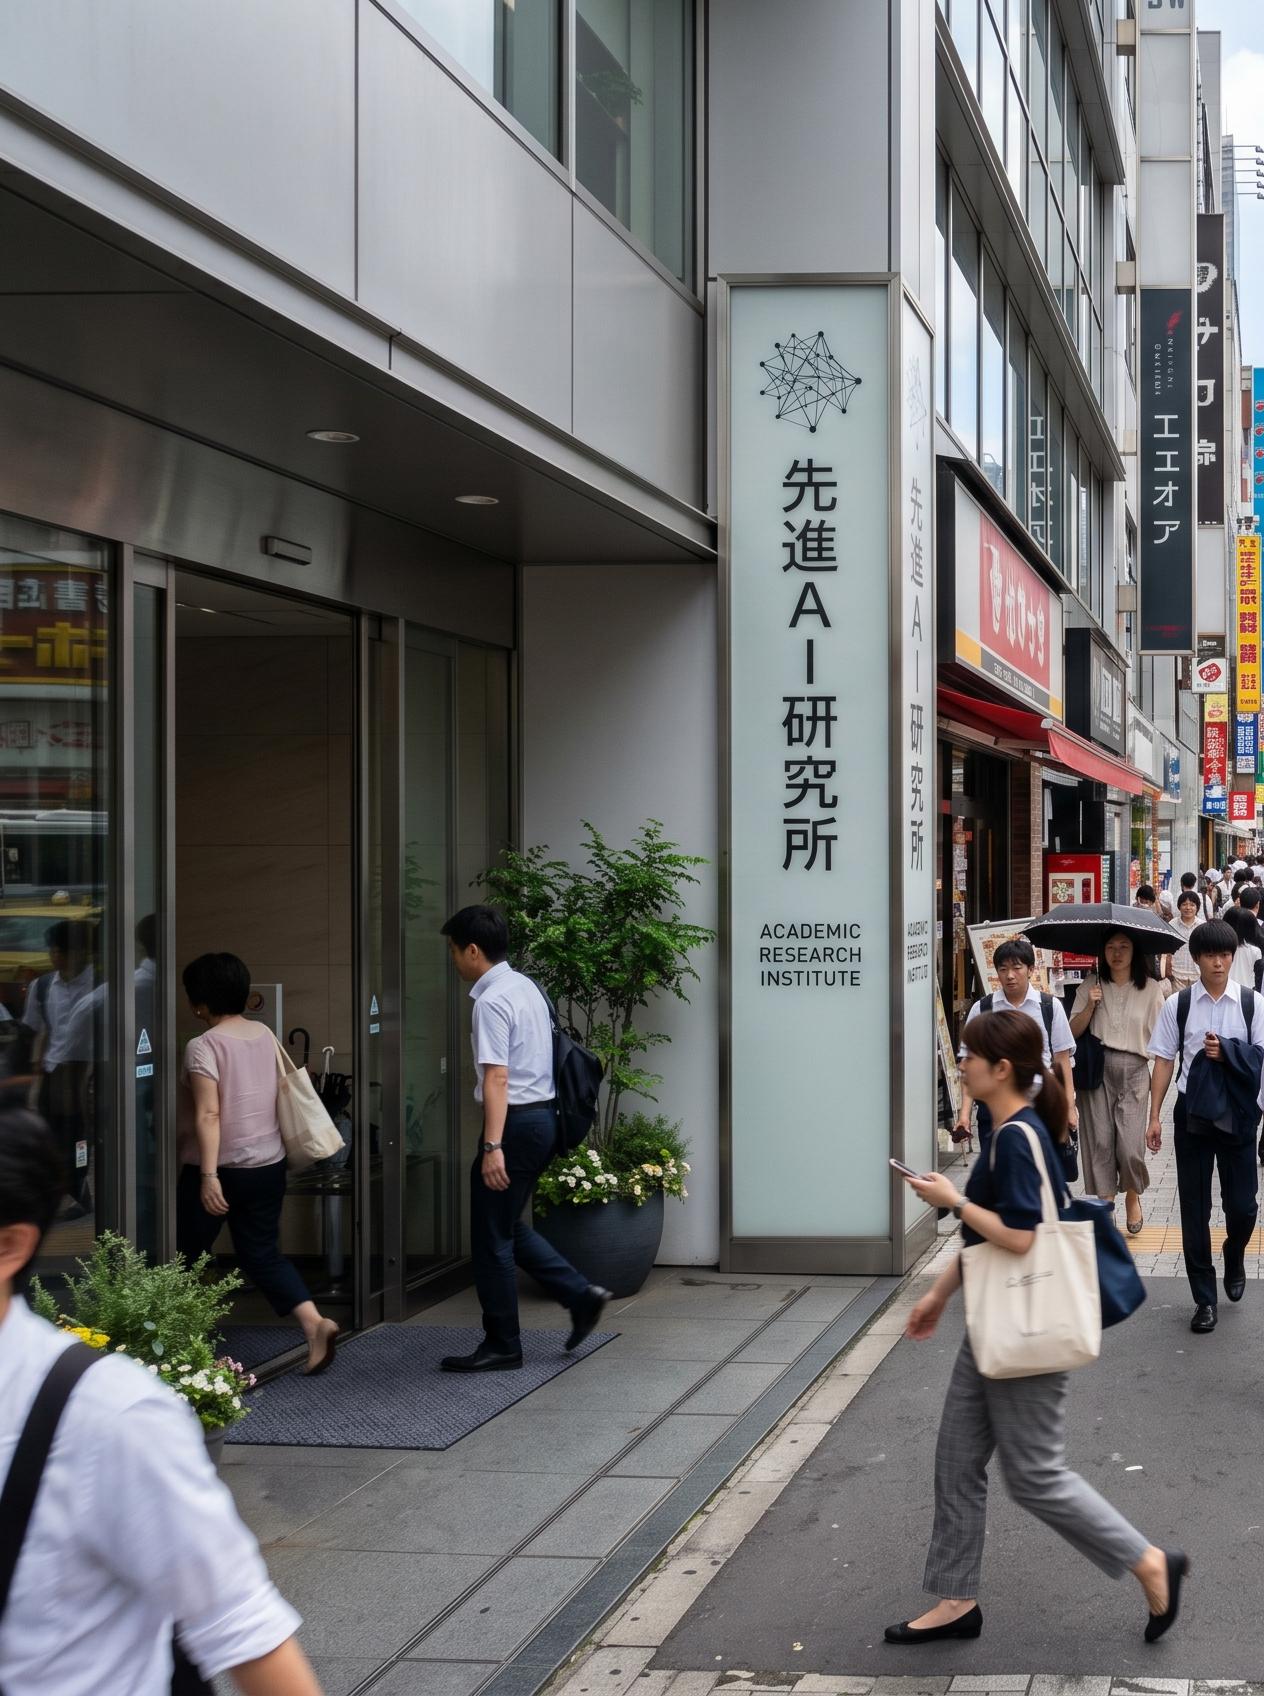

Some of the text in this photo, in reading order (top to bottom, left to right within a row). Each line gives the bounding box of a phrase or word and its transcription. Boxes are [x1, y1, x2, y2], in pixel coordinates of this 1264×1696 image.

[1153, 414, 1181, 544] エエオア
[782, 458, 839, 871] 先進AI研究所
[910, 477, 924, 871] 先進AI研究所
[760, 923, 861, 940] ACADEMIC
[760, 946, 862, 963] RESEARCH
[760, 970, 861, 987] INSTITUTE
